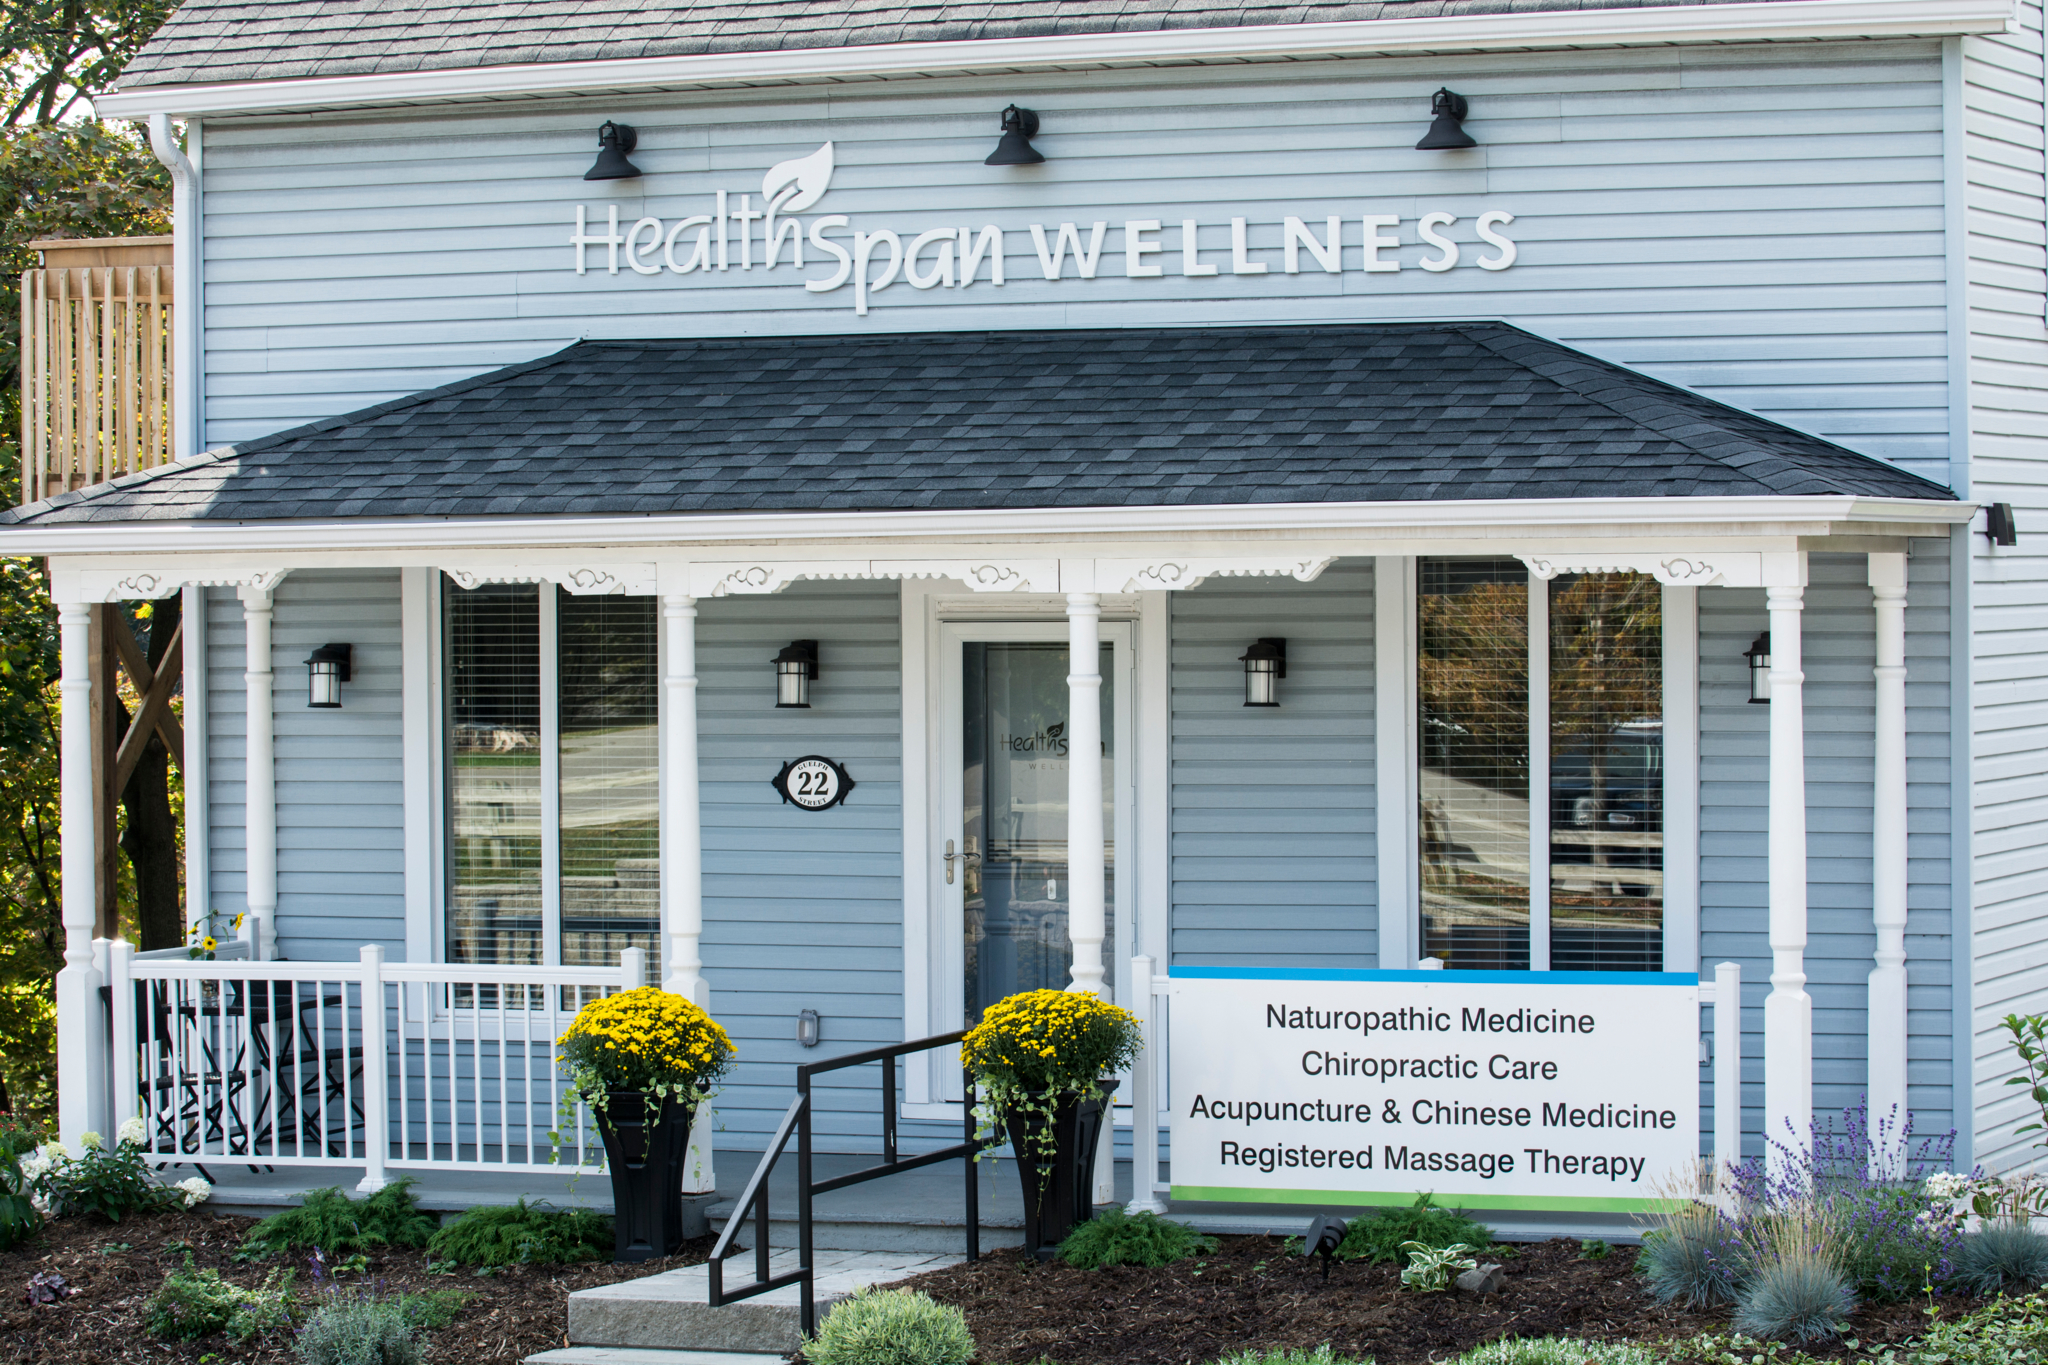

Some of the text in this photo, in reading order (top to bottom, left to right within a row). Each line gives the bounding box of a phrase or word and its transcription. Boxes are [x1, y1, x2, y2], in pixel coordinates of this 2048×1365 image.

[1029, 211, 1518, 280] WELLNESS
[1000, 731, 1105, 757] Healths
[798, 761, 829, 771] GUELPH
[798, 771, 829, 795] 22
[799, 797, 827, 806] STREET
[1266, 1003, 1595, 1037] Naturopathic Medicine
[1301, 1050, 1558, 1084] Chiropractic Care
[1189, 1094, 1676, 1130] Acupuncture & Chinese Medicine
[1220, 1140, 1646, 1183] Registered Massage Therapy
